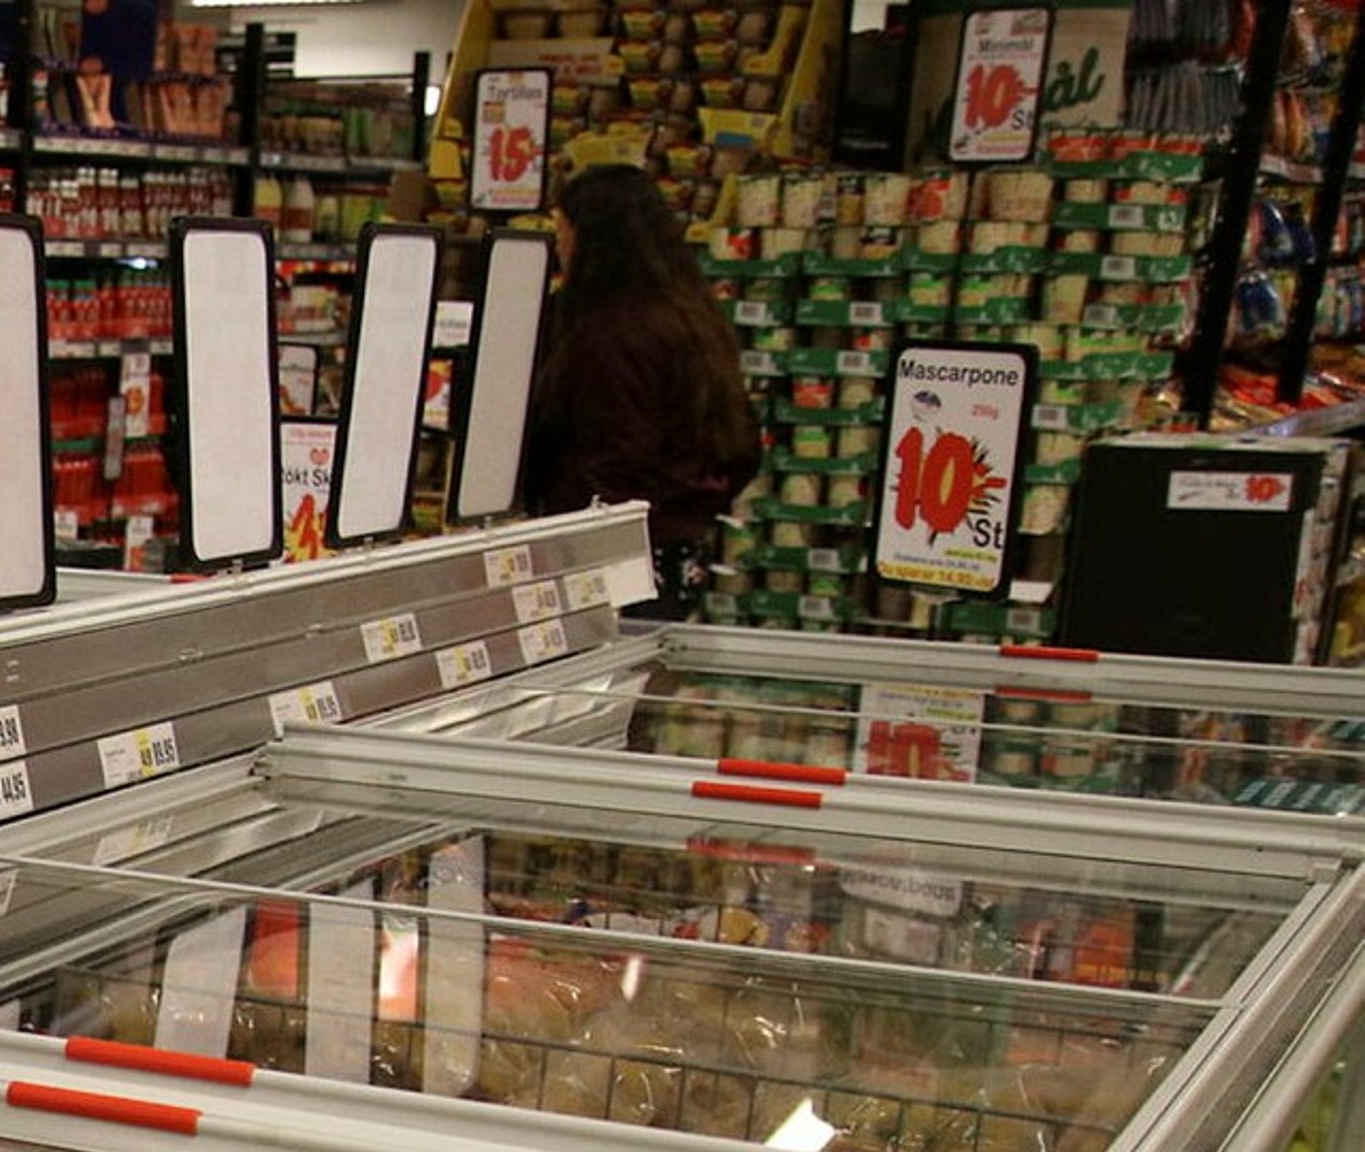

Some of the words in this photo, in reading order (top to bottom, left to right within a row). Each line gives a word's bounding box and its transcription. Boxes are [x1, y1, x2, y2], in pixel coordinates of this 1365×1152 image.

[964, 64, 1021, 129] 10
[488, 125, 535, 183] 15
[899, 358, 1020, 388] Mascarpone
[894, 425, 975, 534] 10
[971, 518, 1004, 549] St
